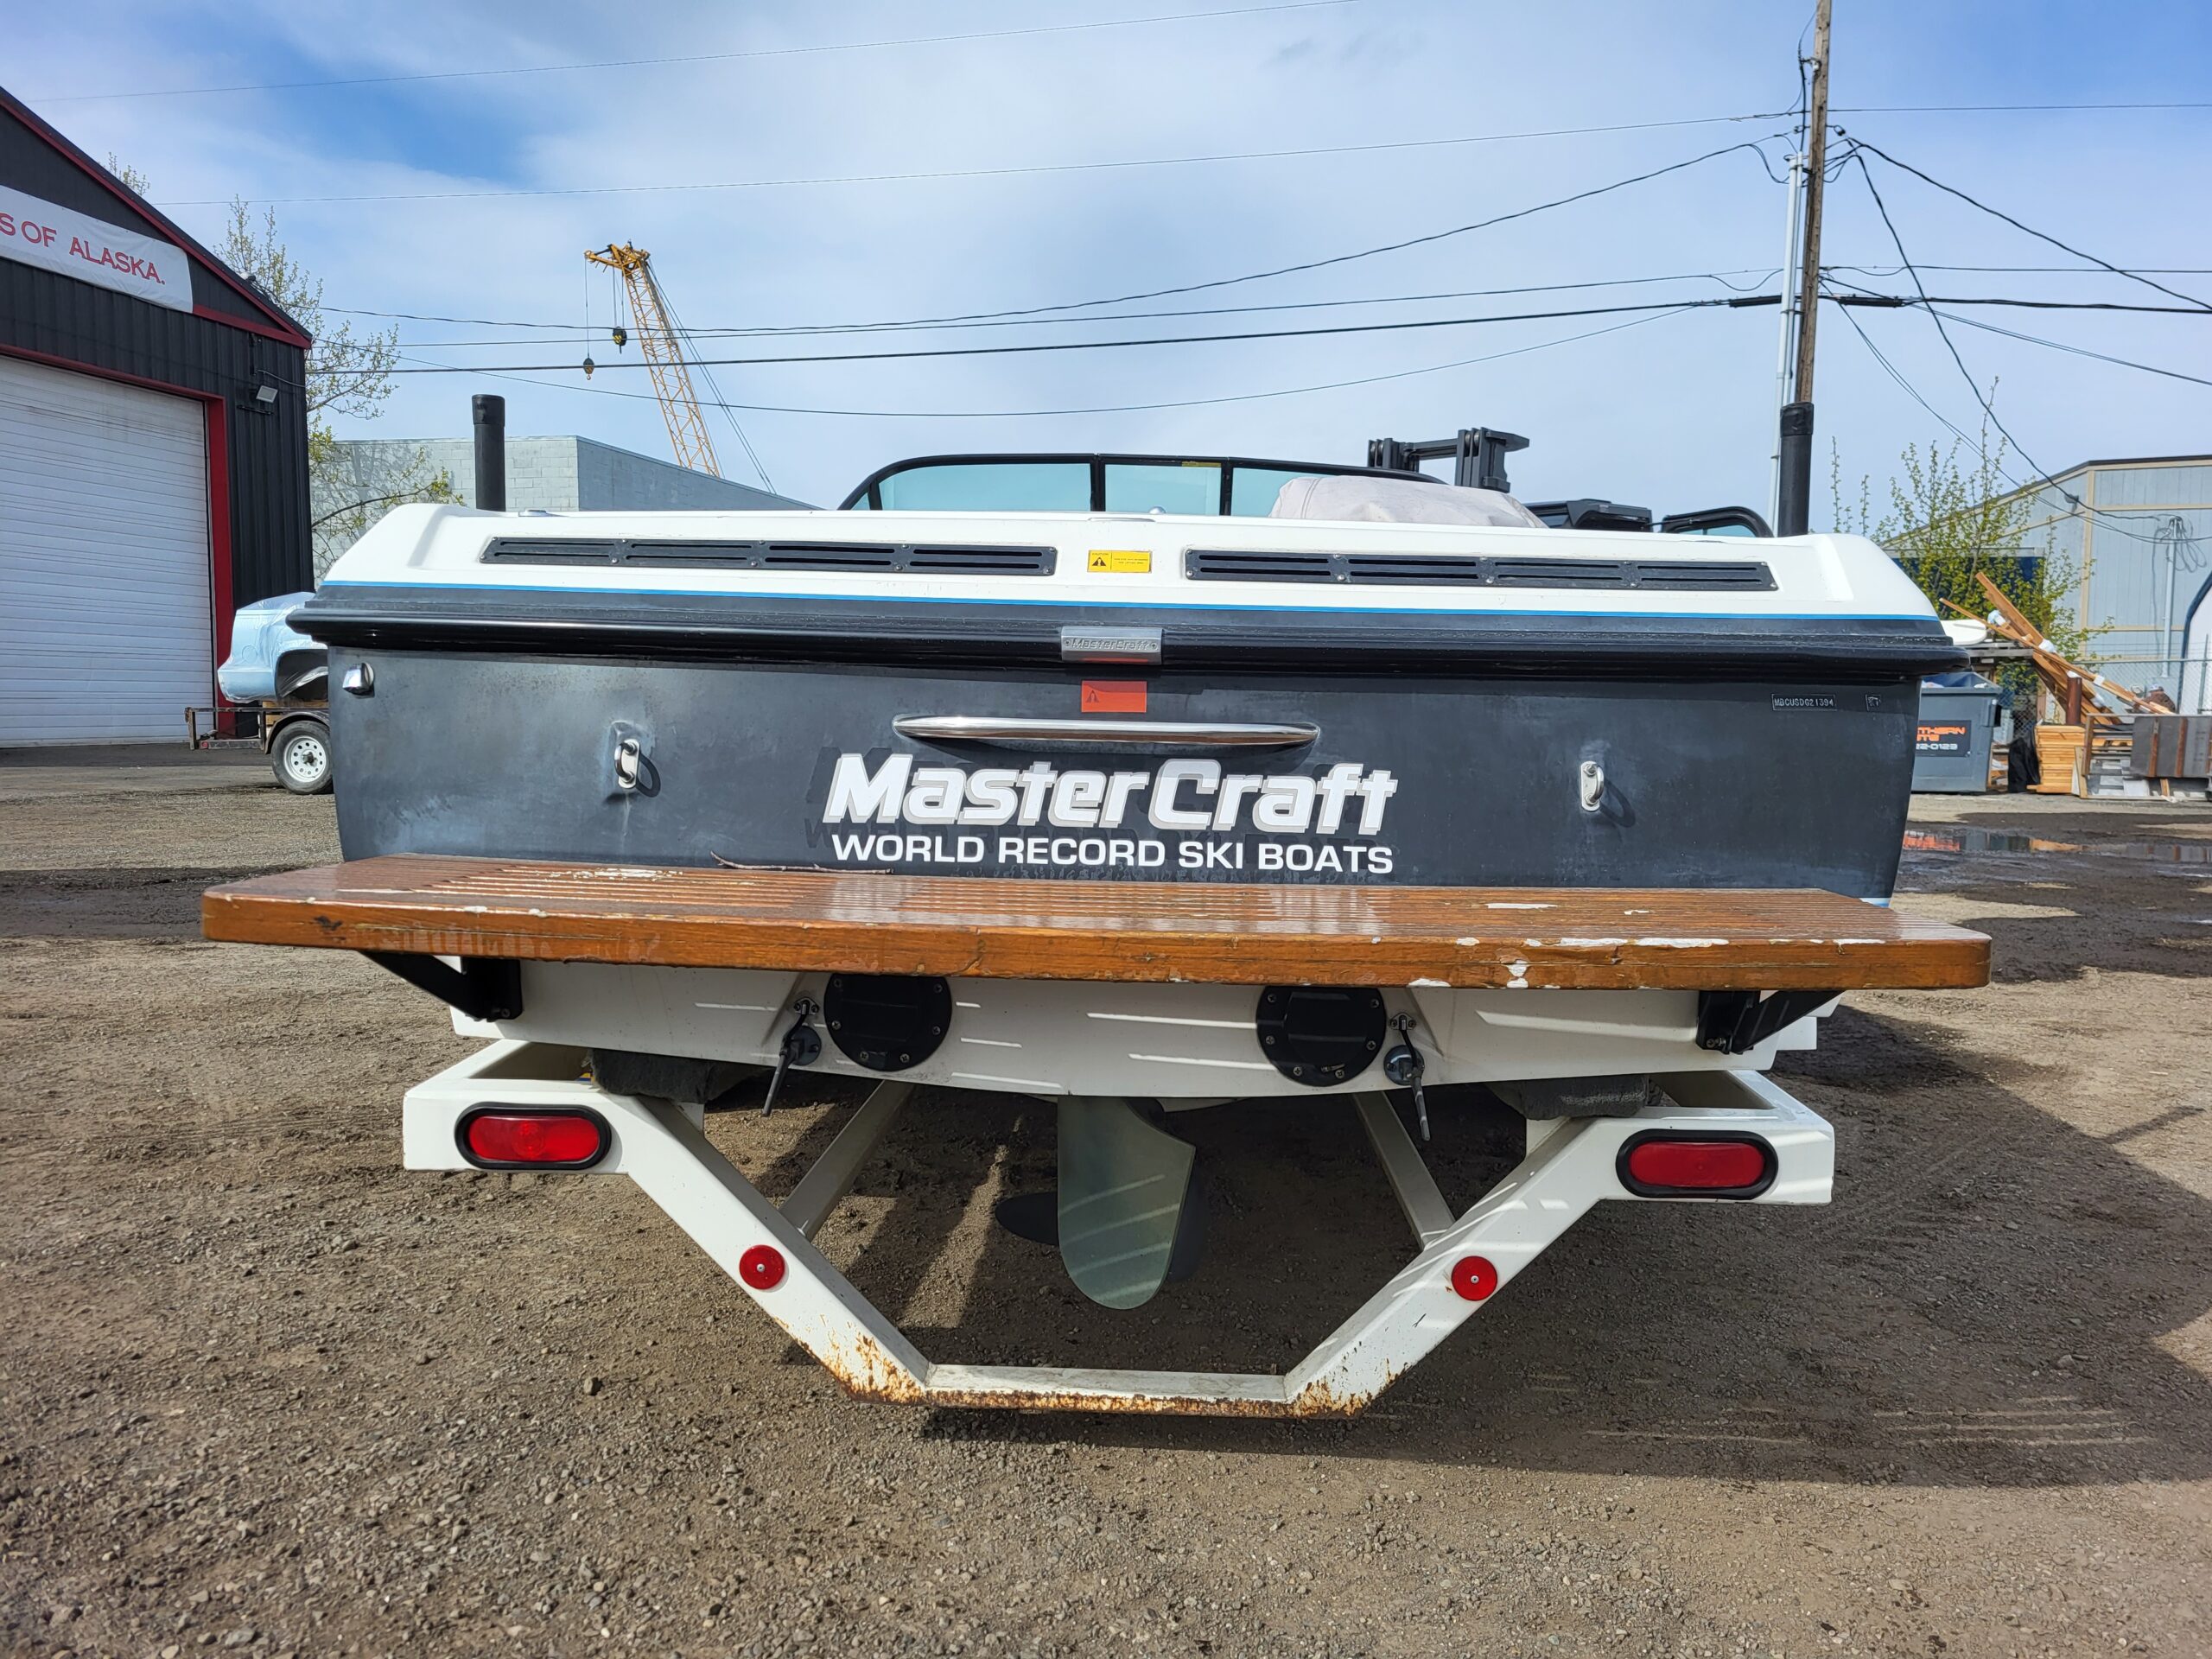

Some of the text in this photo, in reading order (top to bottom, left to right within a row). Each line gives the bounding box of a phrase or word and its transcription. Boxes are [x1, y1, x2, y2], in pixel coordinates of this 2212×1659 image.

[21, 220, 57, 247] OF
[69, 236, 166, 285] ALASKA.
[1071, 638, 1150, 651] MasterCraft
[822, 753, 1399, 836] MasterCraft
[831, 834, 1393, 874] WORLD RECORD SKI BOATS
